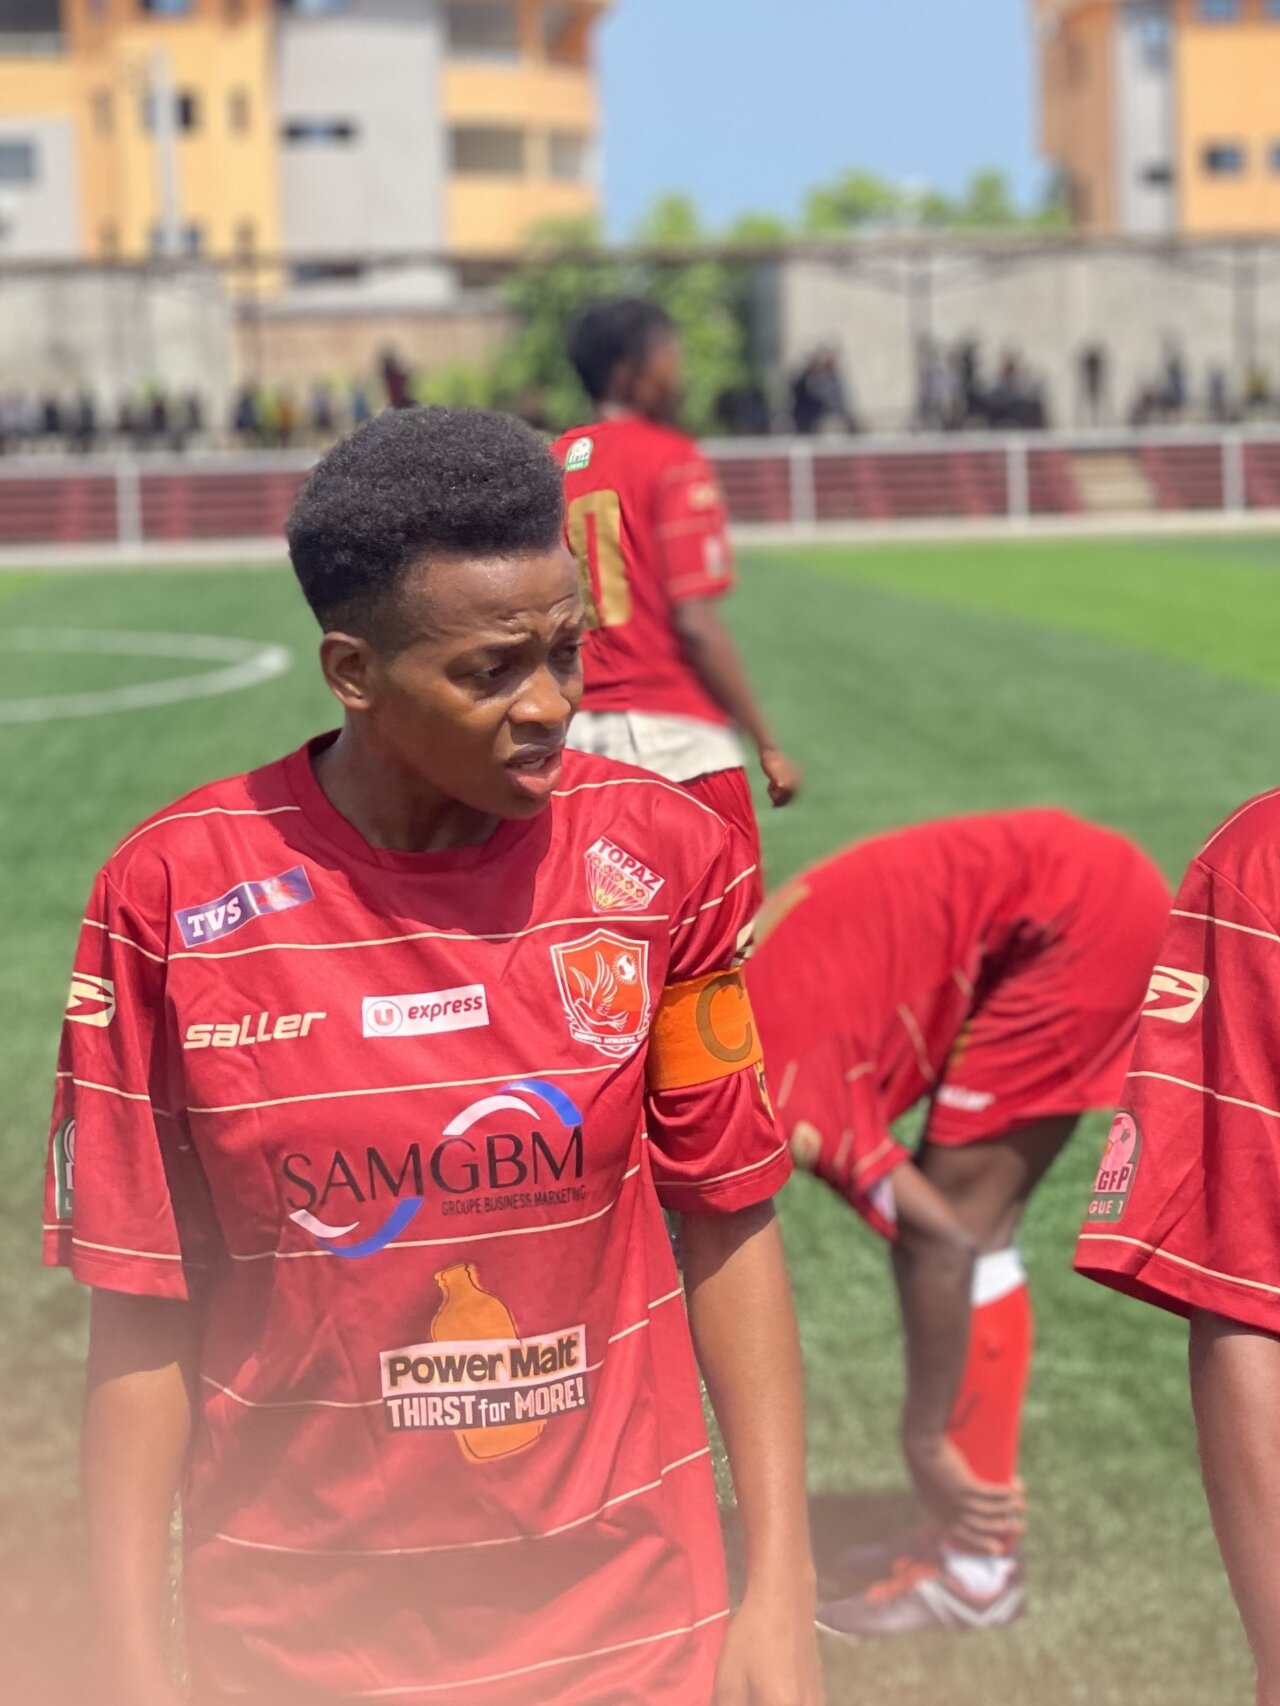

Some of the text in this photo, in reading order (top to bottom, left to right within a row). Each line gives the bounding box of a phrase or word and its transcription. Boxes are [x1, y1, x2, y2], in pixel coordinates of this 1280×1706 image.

[598, 838, 661, 891] TOPAZ
[187, 897, 242, 937] TVS
[183, 1011, 327, 1049] saller
[374, 995, 483, 1026] U express
[695, 973, 753, 1063] C
[282, 1125, 584, 1209] SAMGBM
[1096, 1166, 1130, 1190] GFP
[441, 1184, 587, 1216] GROUPE BUSINESS MARKETING
[1088, 1200, 1124, 1214] GUE 1
[388, 1336, 578, 1386] Power Malt
[387, 1377, 585, 1427] THIRST for MORE!
